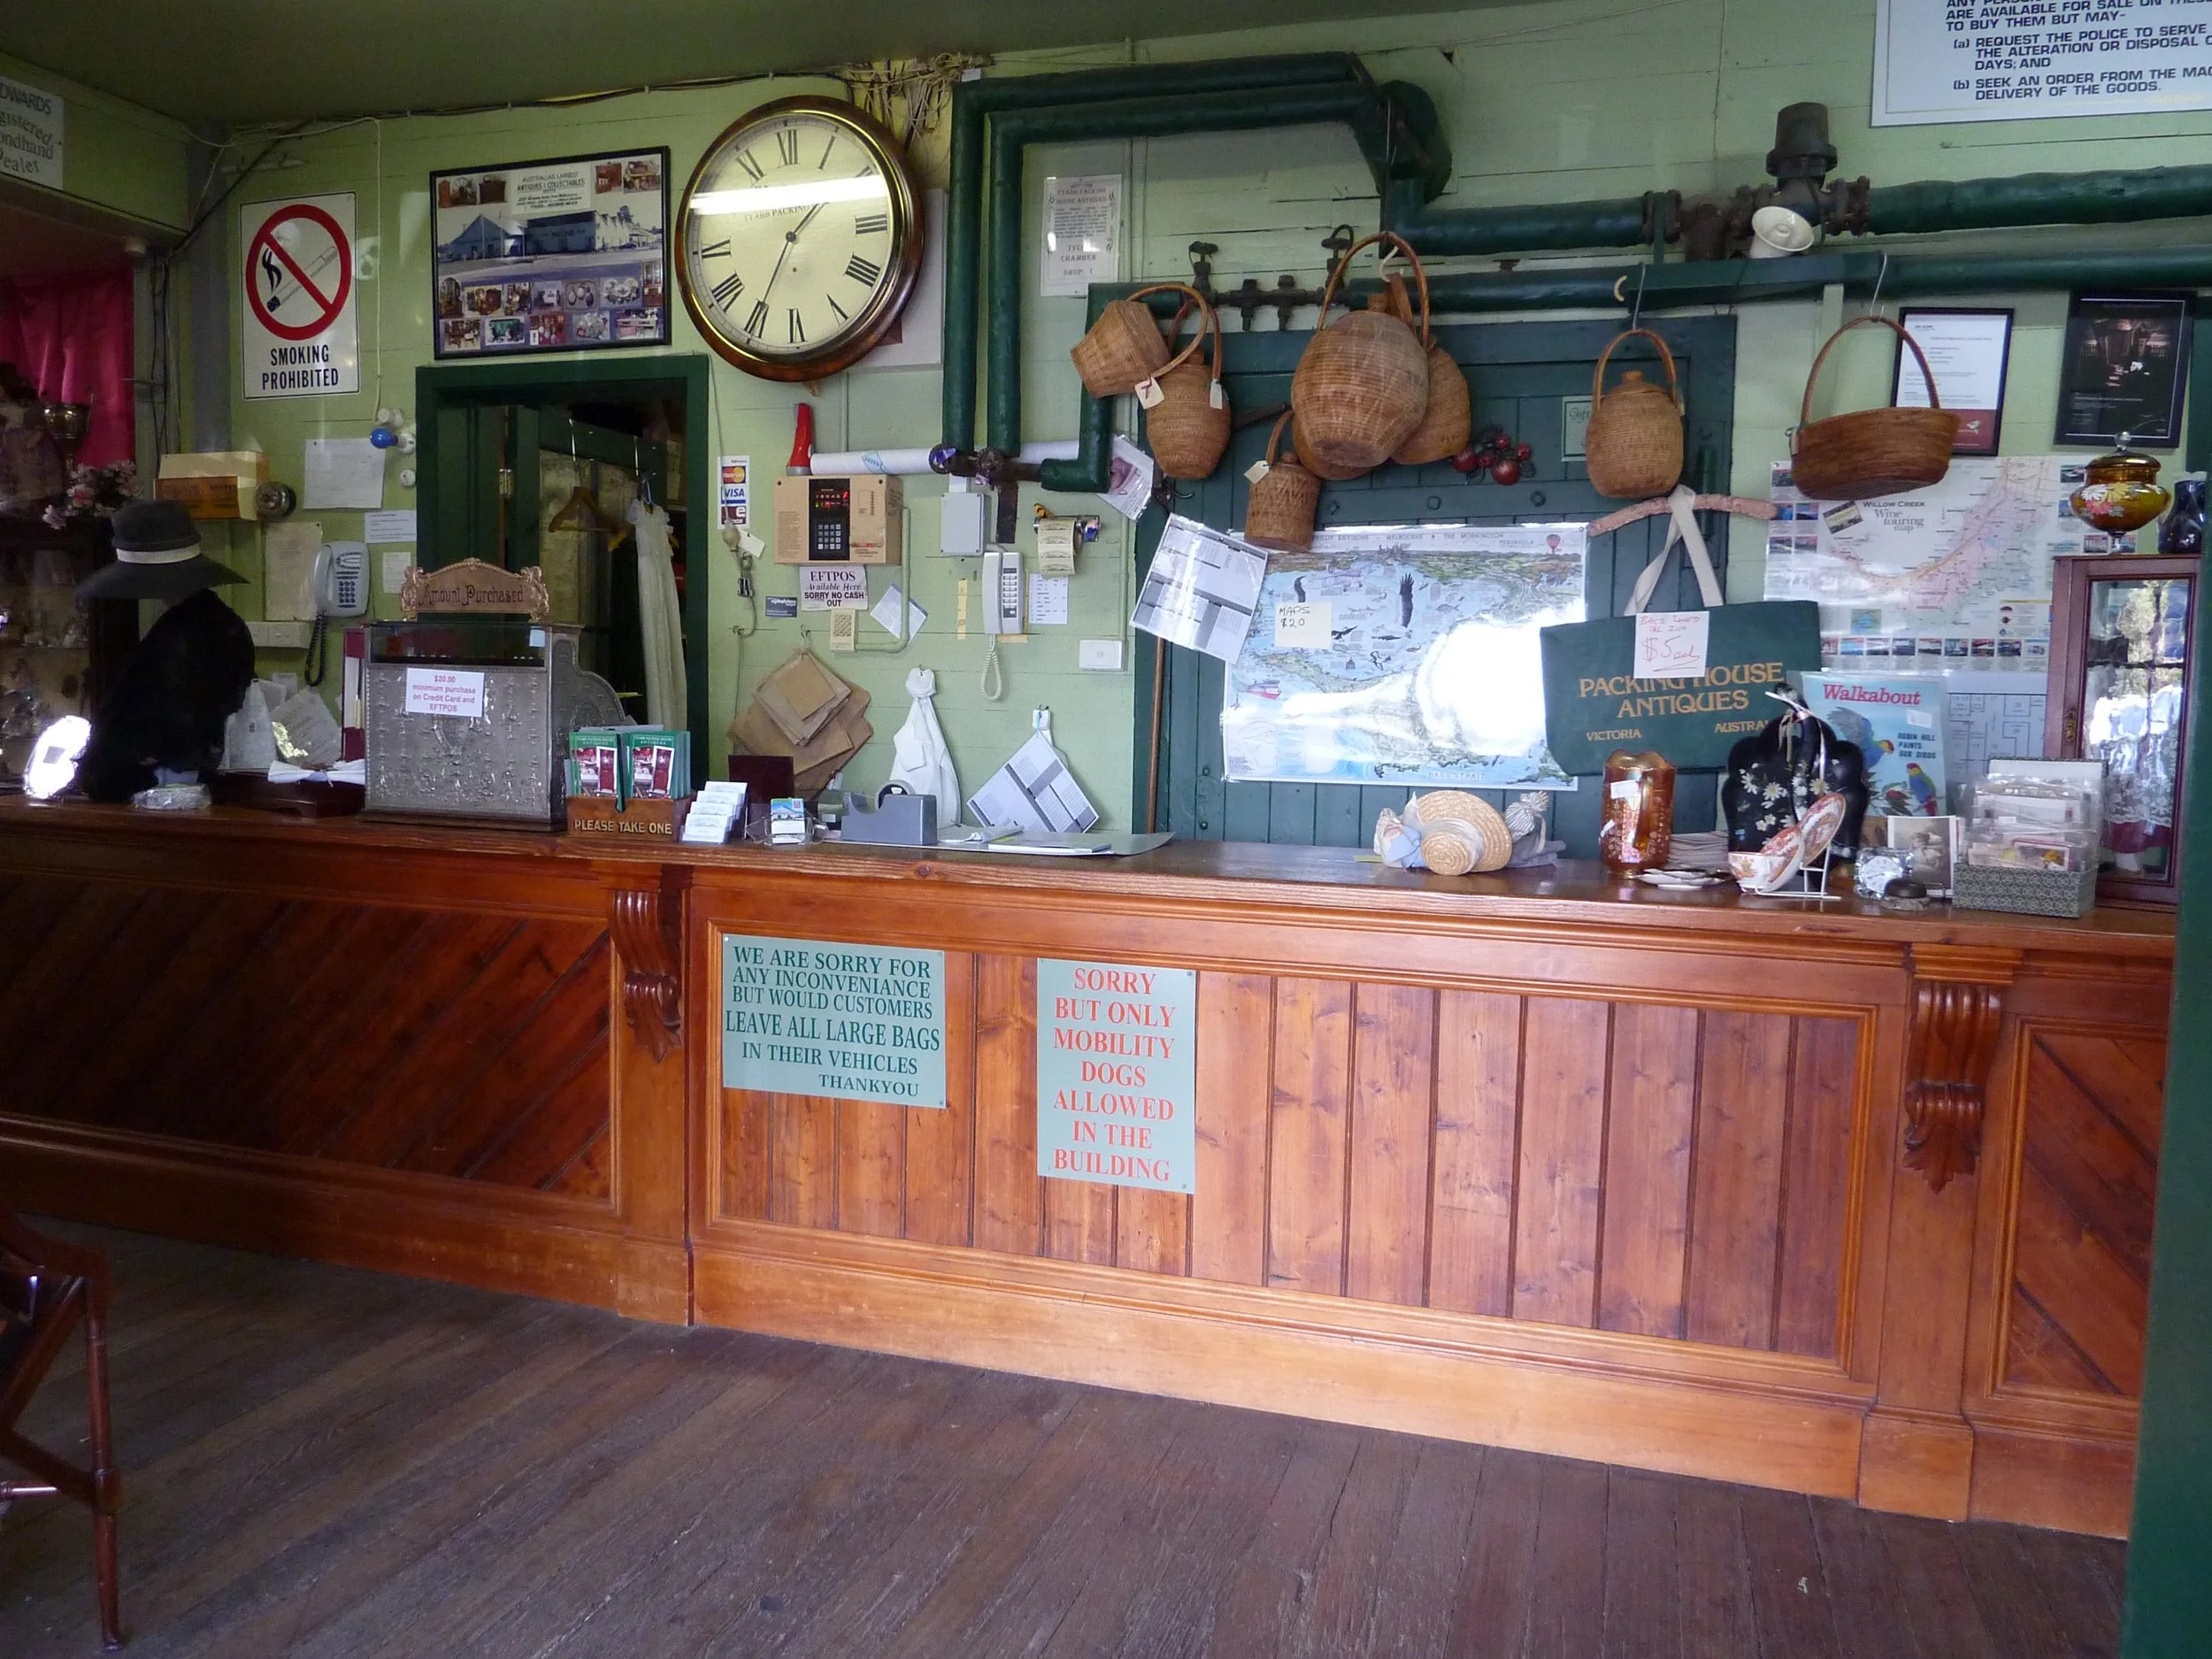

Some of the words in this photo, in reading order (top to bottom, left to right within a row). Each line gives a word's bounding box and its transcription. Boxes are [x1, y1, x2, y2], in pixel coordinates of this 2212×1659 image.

[1947, 9, 1974, 19] ARE
[1980, 4, 2056, 17] AVAILABLE
[2062, 1, 2090, 12] FOR
[2097, 0, 2133, 9] SALE
[1947, 21, 1964, 31] TO
[1970, 19, 1999, 30] BUY
[2005, 16, 2046, 27] THEM
[2052, 13, 2079, 25] BUT
[2085, 11, 2125, 22] MAY-
[1954, 39, 1970, 49] (a)
[1976, 35, 2039, 47] REQUEST
[2046, 32, 2072, 42] THE
[2078, 28, 2128, 41] POLICE
[2135, 27, 2153, 37] TO
[2159, 24, 2207, 36] SERVE
[1976, 48, 2001, 58] THE
[2008, 42, 2093, 57] ALTERATION
[2100, 41, 2120, 51] OR
[2125, 36, 2199, 50] DISPOSAL
[1975, 58, 2016, 70] DAYS;
[2019, 57, 2051, 68] AND
[1954, 80, 1970, 89] (b)
[1976, 77, 2011, 88] SEEK
[2018, 76, 2039, 86] AN
[2046, 73, 2093, 85] ORDER
[2100, 70, 2142, 82] FROM
[2149, 68, 2176, 80] THE
[1976, 88, 2042, 100] DELIVERY
[2048, 86, 2067, 96] OF
[2073, 84, 2100, 95] THE
[2106, 81, 2161, 94] GOODS.
[270, 344, 329, 365] SMOKING
[262, 368, 339, 390] PROHIBITED
[725, 488, 745, 497] VISA
[1875, 509, 1901, 518] Wine
[1884, 517, 1924, 528] touring
[1893, 526, 1914, 534] map
[810, 571, 856, 581] EFTPOS
[419, 583, 461, 606] Amount
[461, 584, 524, 607] Purchased
[1279, 605, 1310, 616] MAPS
[445, 686, 476, 695] purchase
[1823, 684, 1921, 705] Walkabout
[1617, 689, 1750, 718] ANTIQUES
[1586, 729, 1642, 741] VICTORIA
[1714, 719, 1769, 733] AUSTRA
[574, 819, 615, 832] PLEASE
[618, 821, 646, 833] TAKE
[649, 822, 672, 834] ONE
[733, 946, 764, 965] WE
[770, 949, 809, 968] ARE
[815, 952, 882, 974] SORRY
[889, 958, 931, 979] FOR
[732, 966, 769, 985] ANY
[775, 970, 931, 999] INCONVENIANCE
[1074, 967, 1156, 995] SORRY
[733, 985, 764, 1003] BUT
[768, 988, 828, 1010] WOULD
[833, 994, 933, 1019] CUSTOMERS
[1055, 997, 1101, 1021] BUT
[1108, 1002, 1175, 1028] ONLY
[726, 1010, 782, 1036] LEAVE
[787, 1016, 821, 1039] ALL
[826, 1018, 887, 1046] LARGE
[891, 1025, 940, 1051] BAGS
[1053, 1027, 1175, 1059] MOBILITY
[742, 1041, 763, 1059] IN
[767, 1044, 823, 1065] THEIR
[828, 1049, 918, 1075] VEHICLES
[1081, 1060, 1147, 1087] DOGS
[818, 1073, 919, 1097] THANKYOU
[1053, 1089, 1175, 1120] ALLOWED
[1072, 1120, 1097, 1142] IN
[1104, 1124, 1152, 1149] THE
[1054, 1148, 1171, 1182] BUILDING
